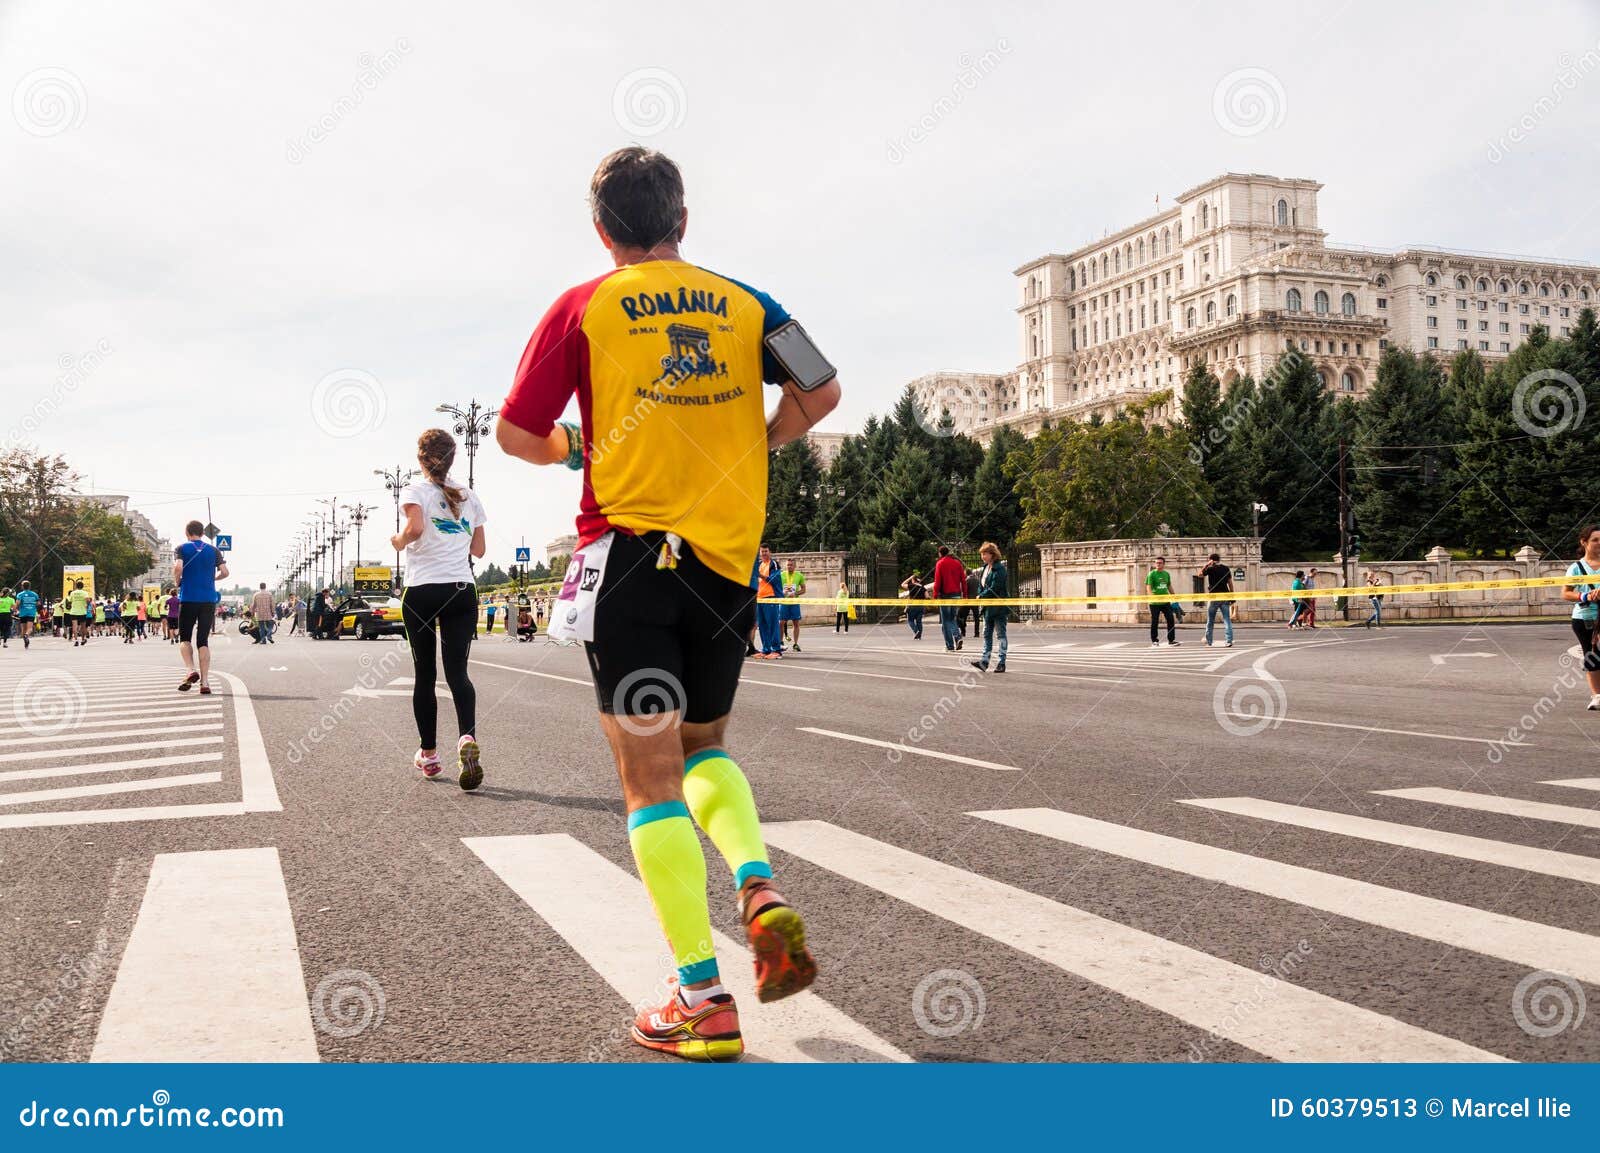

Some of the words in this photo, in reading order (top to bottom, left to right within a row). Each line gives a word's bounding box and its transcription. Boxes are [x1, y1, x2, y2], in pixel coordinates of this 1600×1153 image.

[620, 287, 728, 321] ROMÂNIA
[633, 386, 712, 406] MARATONUL
[714, 386, 745, 404] REGAL
